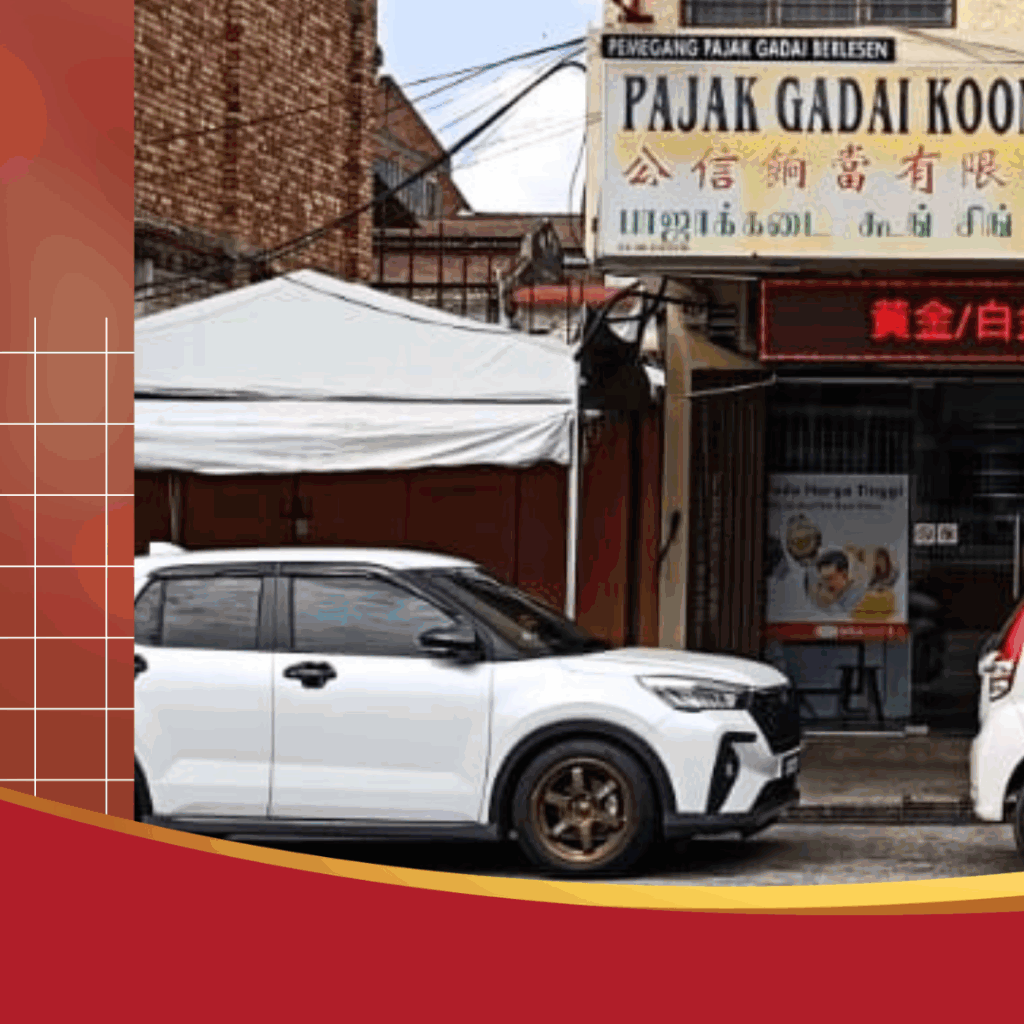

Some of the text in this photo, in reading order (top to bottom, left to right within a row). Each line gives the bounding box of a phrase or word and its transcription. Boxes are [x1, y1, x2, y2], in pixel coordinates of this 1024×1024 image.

[703, 39, 750, 57] PAJAK
[756, 39, 807, 58] GADAI
[623, 76, 760, 132] PAJAK
[775, 76, 910, 134] GADAI
